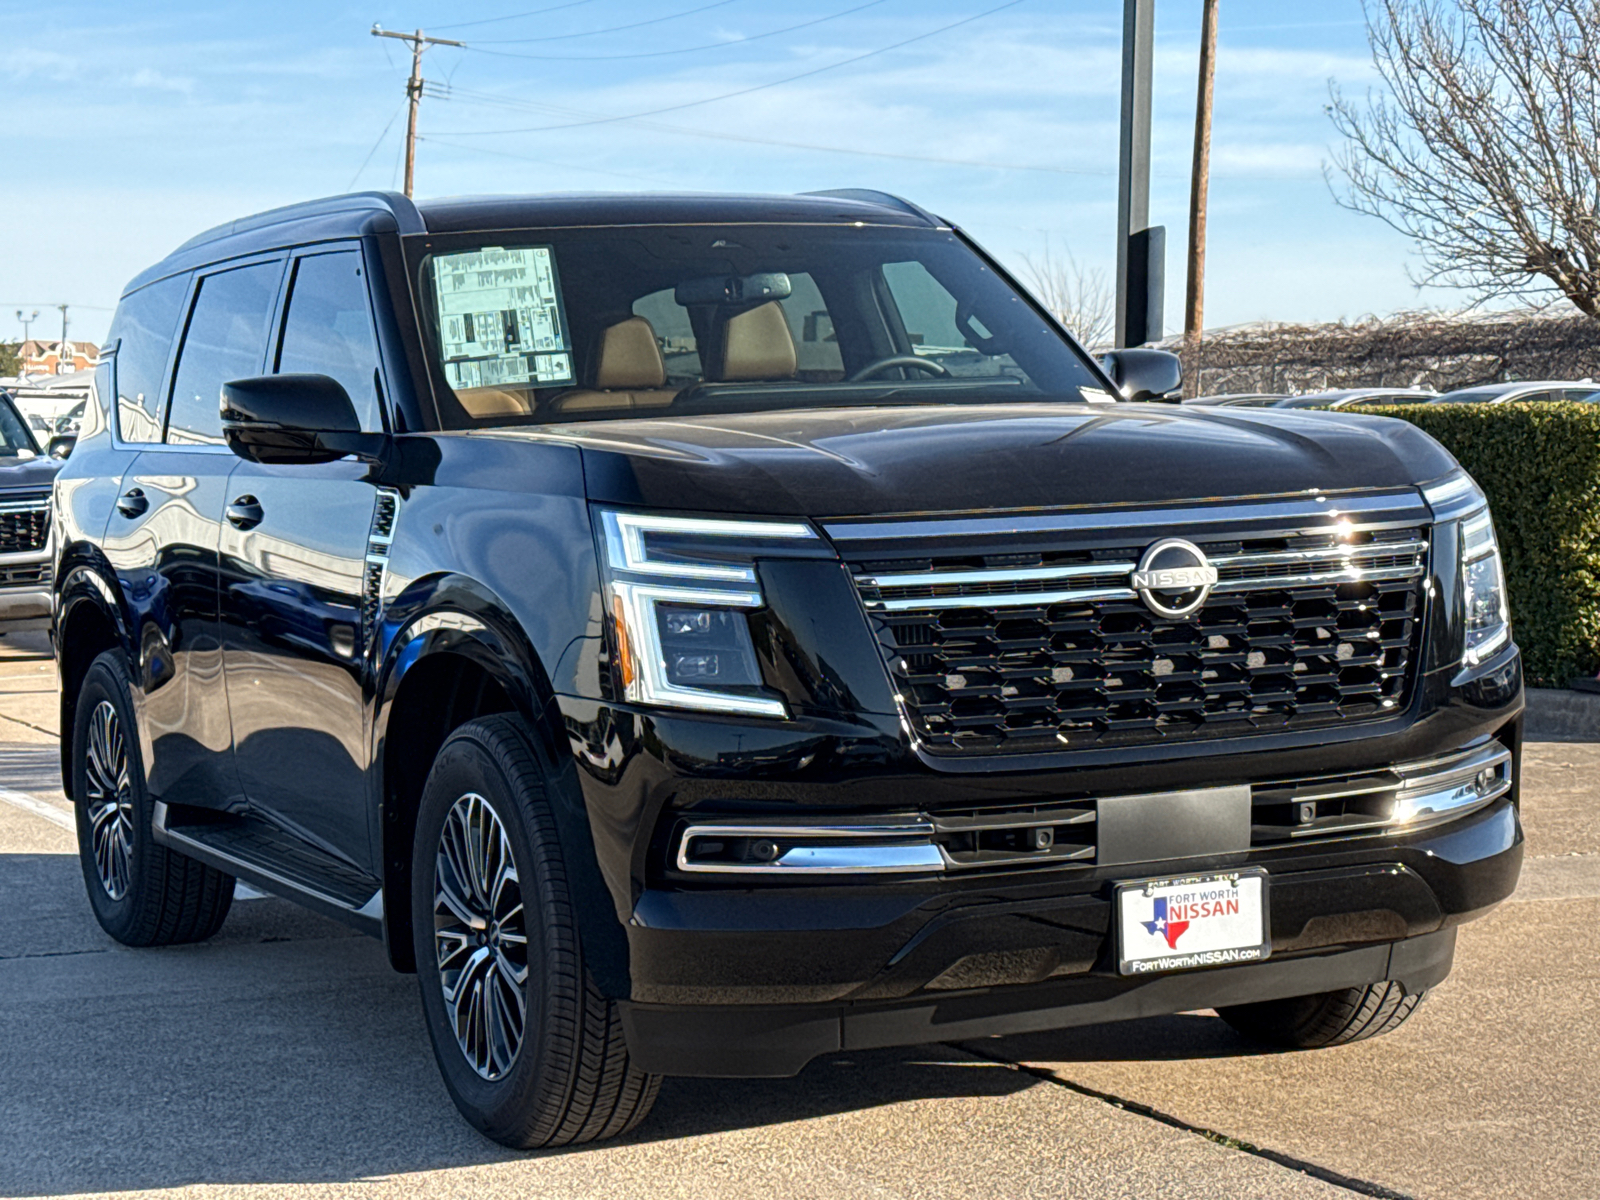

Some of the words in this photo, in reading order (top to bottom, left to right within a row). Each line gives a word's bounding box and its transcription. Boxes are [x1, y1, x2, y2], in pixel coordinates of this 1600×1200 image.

[1134, 570, 1214, 587] NISSAN
[1169, 892, 1196, 904] FORT
[1199, 888, 1239, 901] WORTH
[1169, 898, 1239, 921] NISSAN
